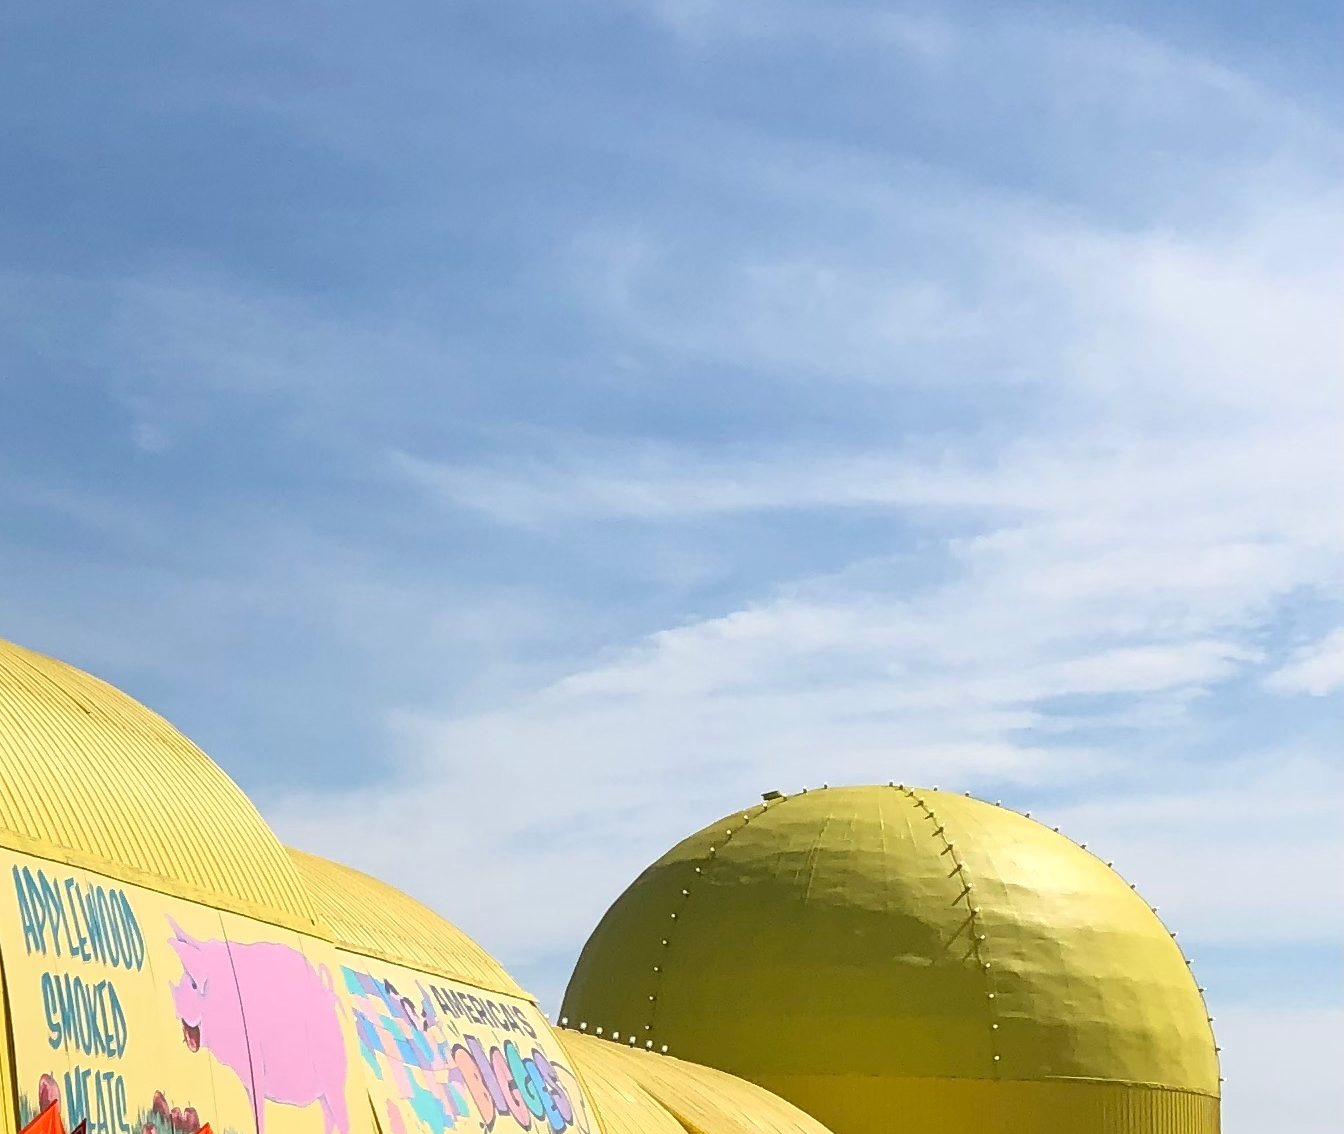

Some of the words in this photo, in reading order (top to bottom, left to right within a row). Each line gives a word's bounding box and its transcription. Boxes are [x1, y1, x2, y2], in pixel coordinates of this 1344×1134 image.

[12, 864, 145, 972] APPLEWOOD
[42, 972, 128, 1060] SMOKED
[429, 984, 538, 1039] AMERICA'S
